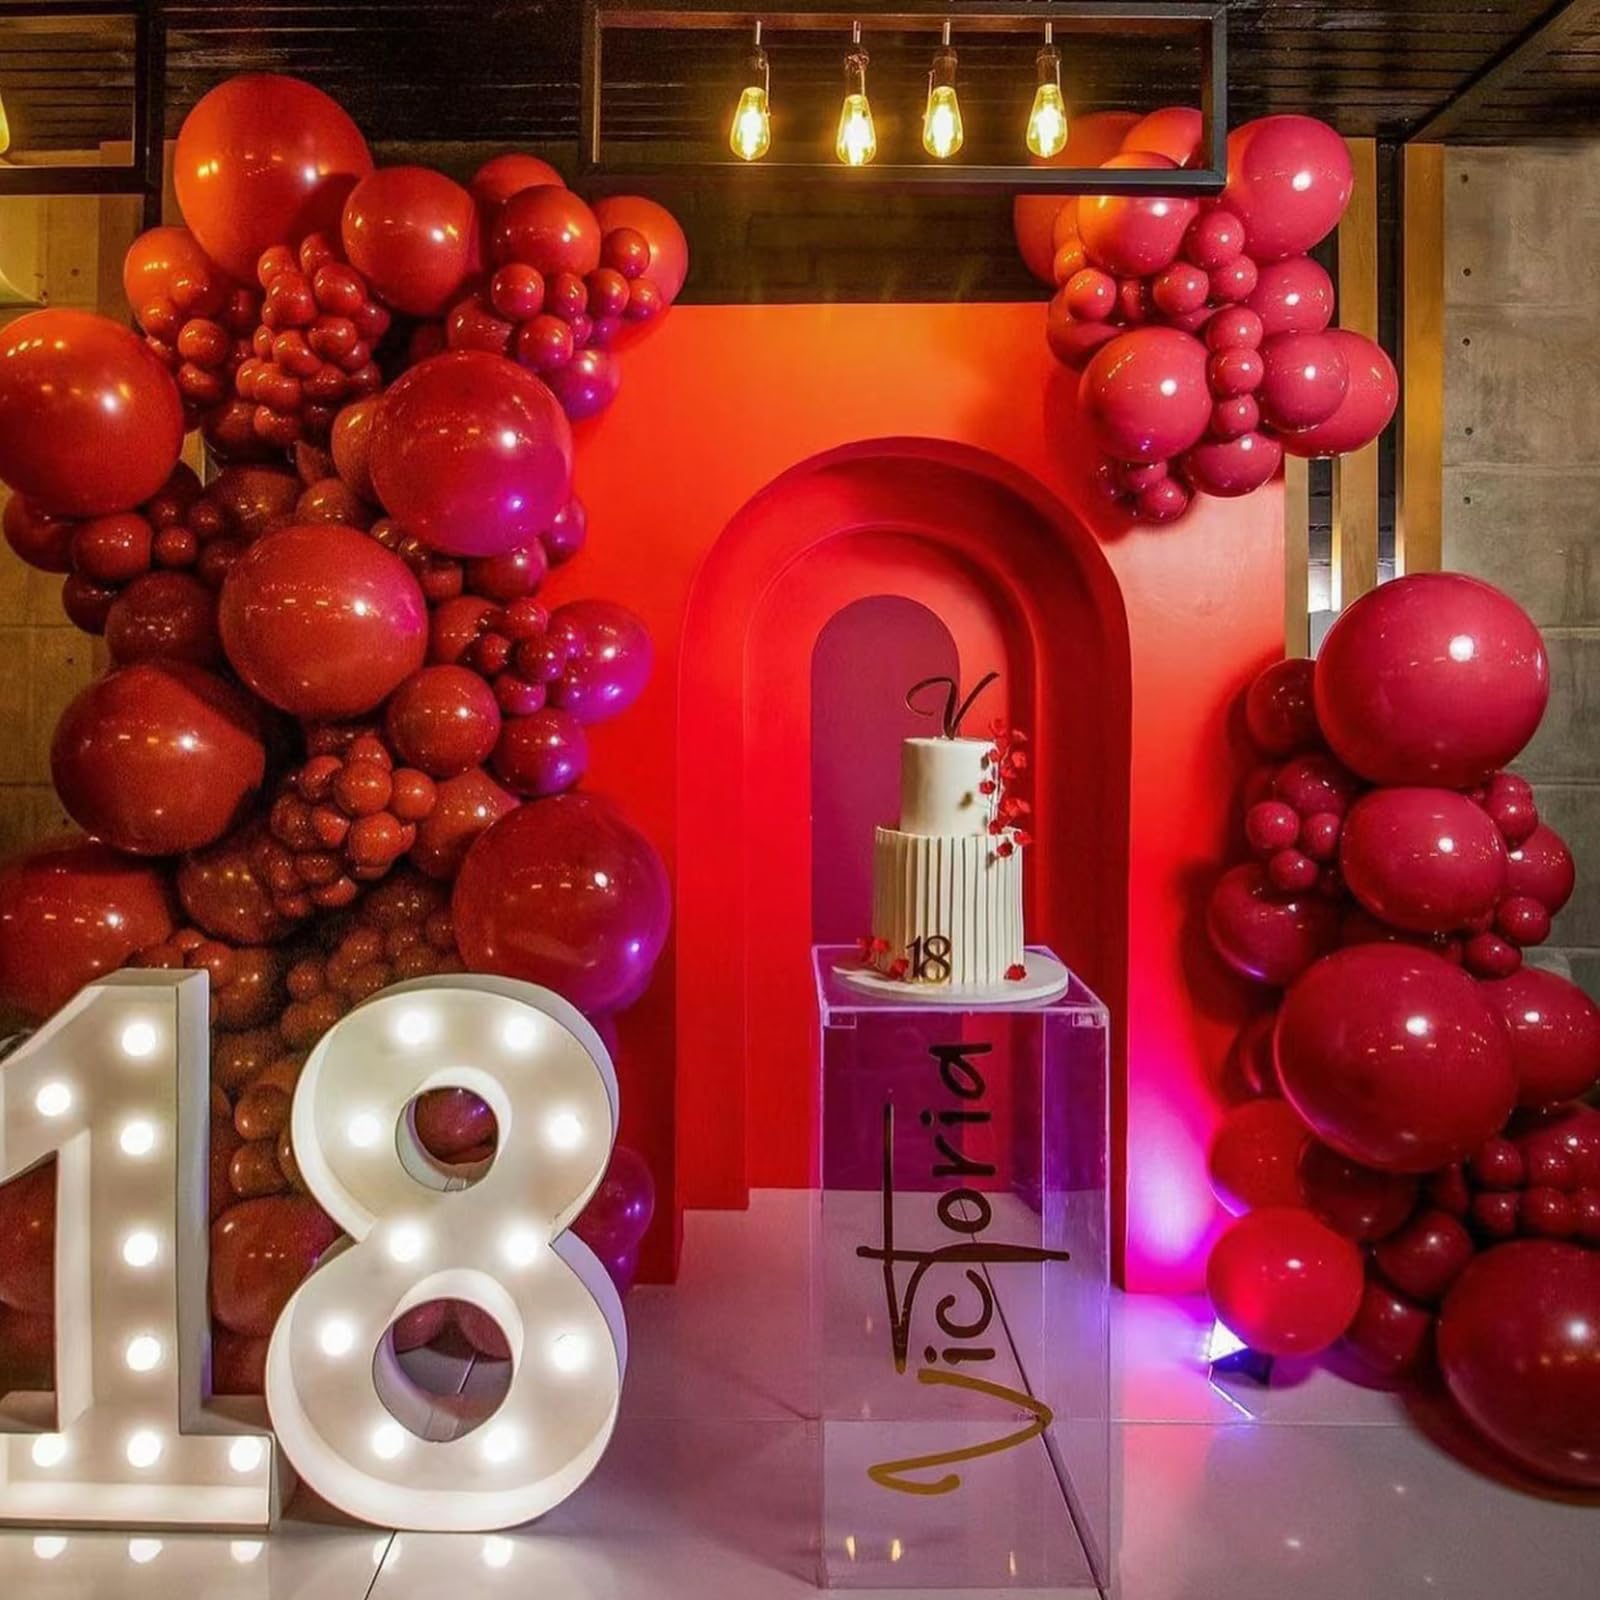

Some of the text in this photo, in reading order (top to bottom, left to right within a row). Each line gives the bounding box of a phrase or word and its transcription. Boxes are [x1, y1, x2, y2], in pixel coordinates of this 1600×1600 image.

[906, 671, 999, 739] V
[905, 935, 951, 984] 18
[0, 968, 628, 1532] 18
[856, 1042, 1070, 1495] Victoria
